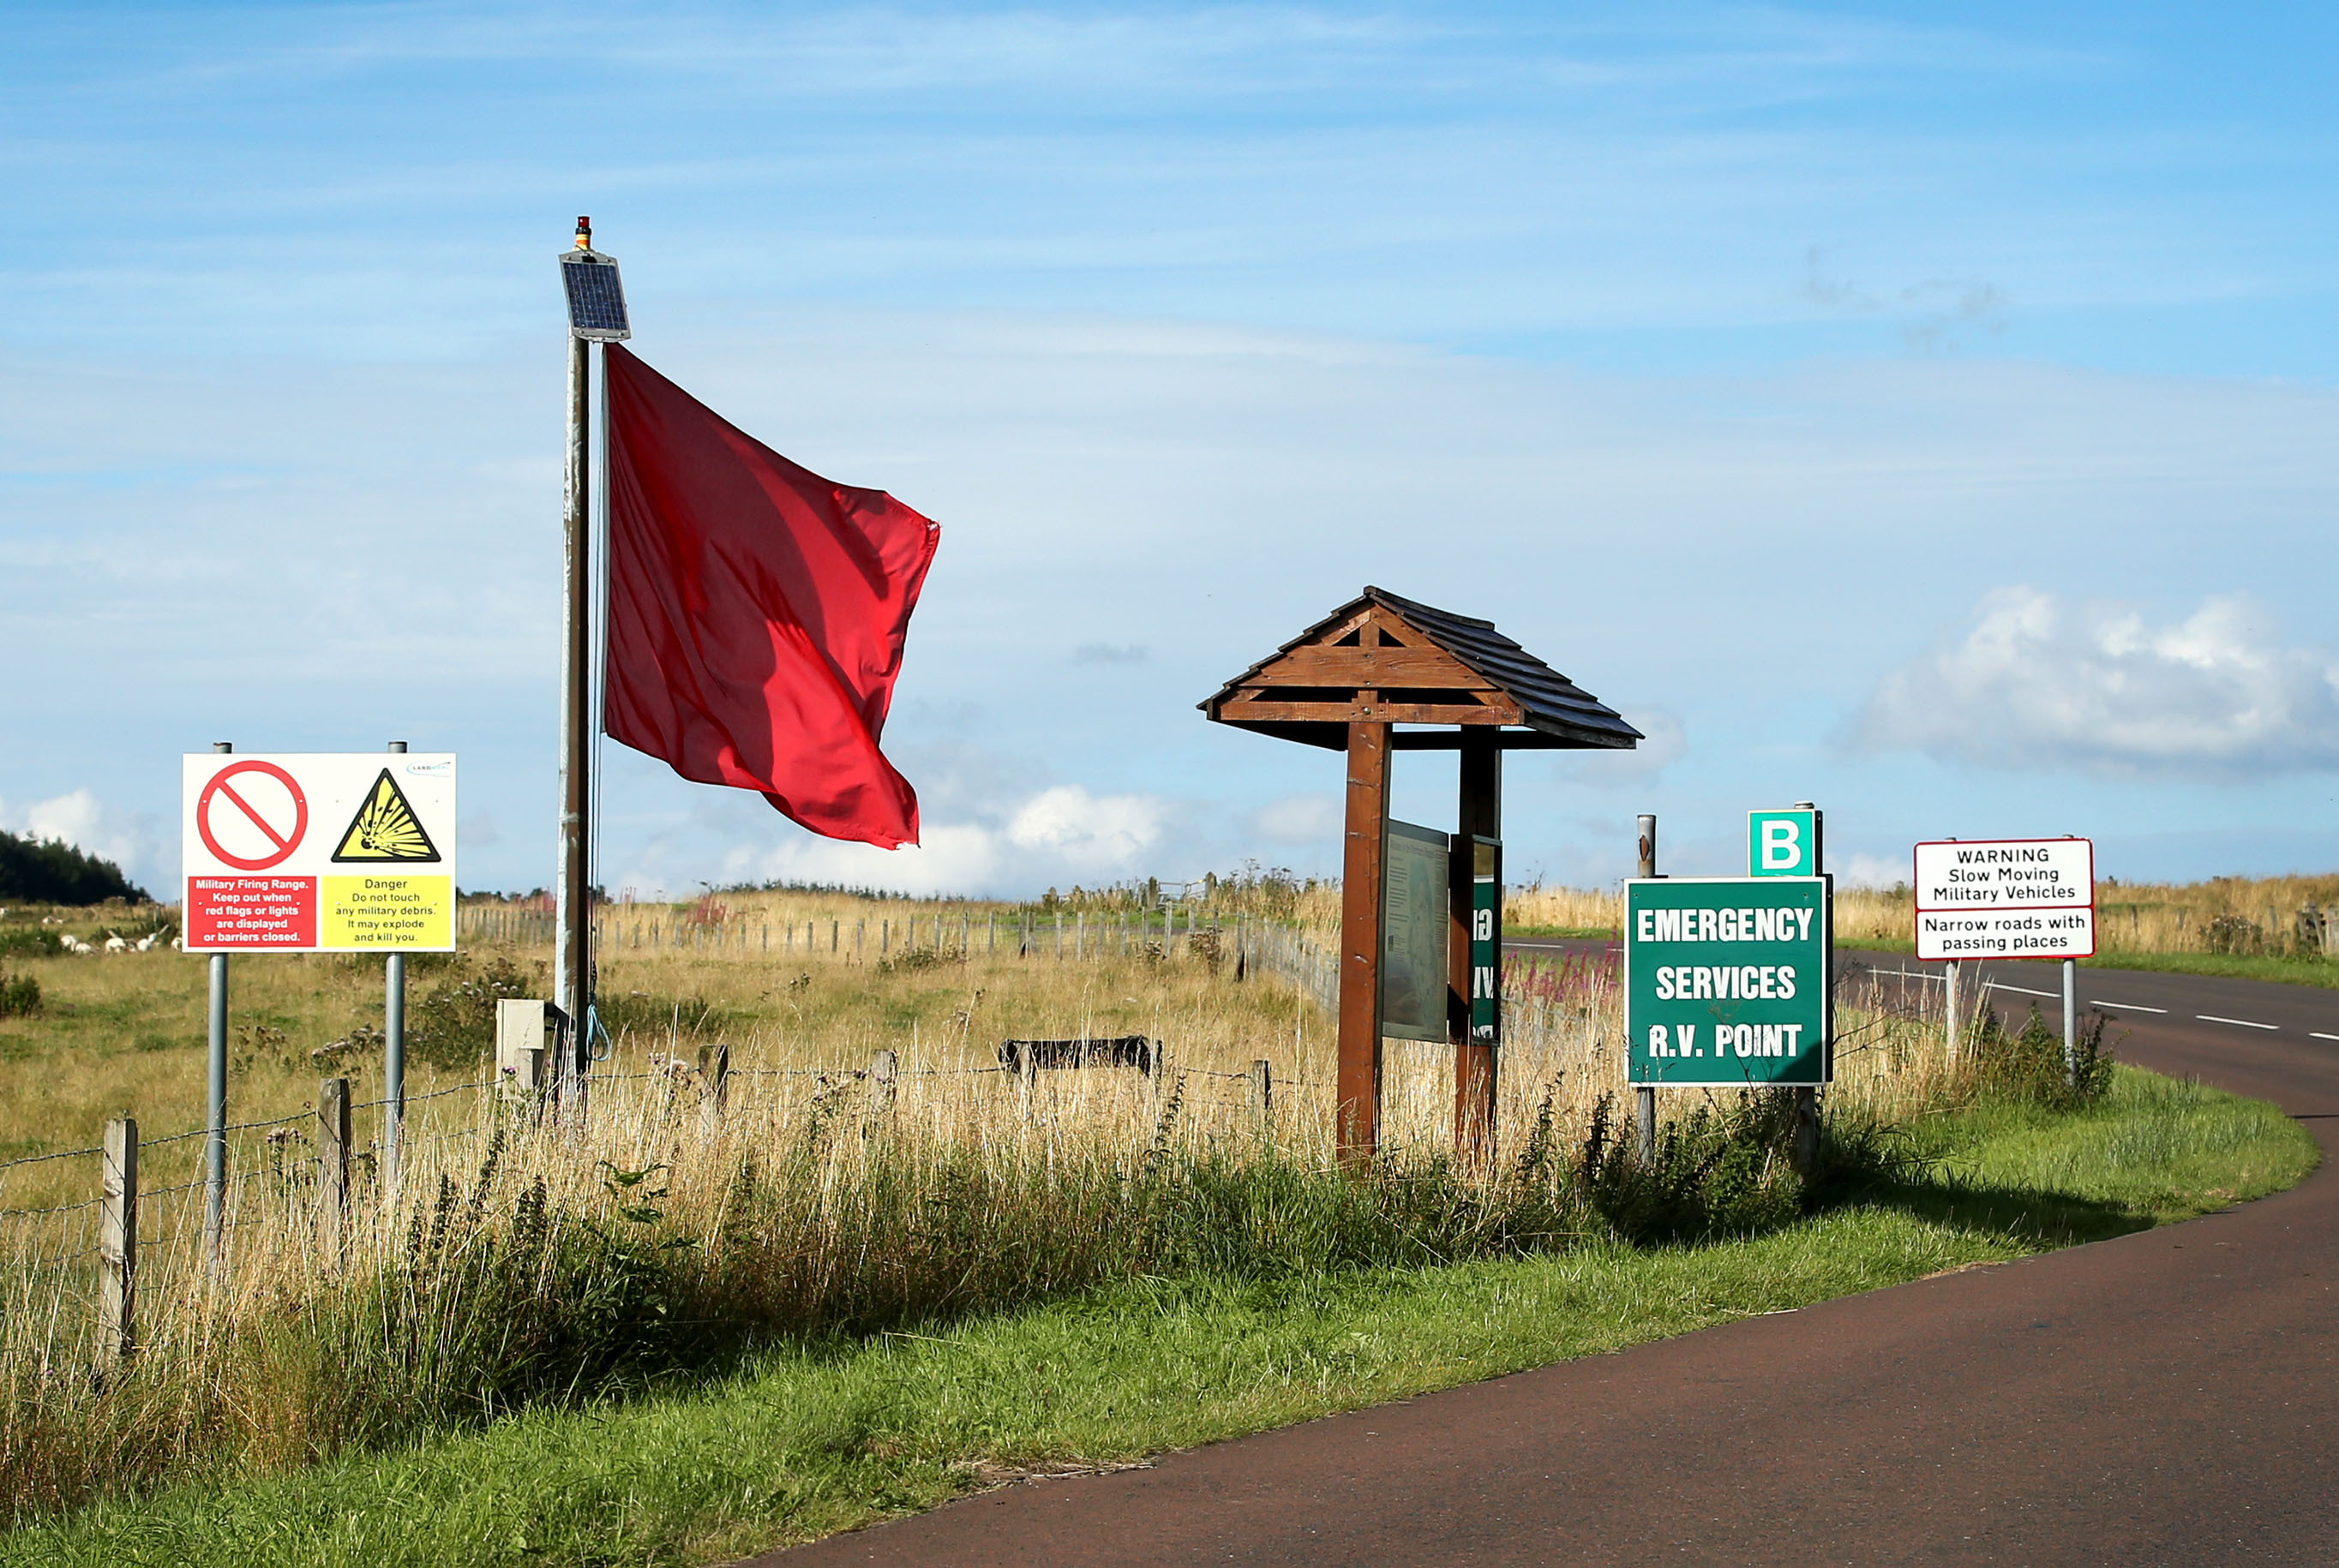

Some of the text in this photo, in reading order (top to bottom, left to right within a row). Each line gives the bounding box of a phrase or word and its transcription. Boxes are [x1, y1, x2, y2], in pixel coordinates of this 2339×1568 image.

[1761, 820, 1801, 870] B
[1958, 849, 2049, 864] WARNING
[1949, 867, 2059, 883] Slow Moving
[196, 880, 308, 891] Military Firing Range.
[365, 879, 407, 890] Danger
[213, 893, 291, 904] Keep out when
[390, 893, 420, 902] touch
[1934, 885, 2075, 902] Military Vehicles
[206, 906, 224, 915] red
[226, 906, 252, 917] flags
[269, 906, 298, 917] lights
[336, 906, 436, 917] any military debris.
[237, 919, 288, 931] displayed
[357, 921, 380, 931] may
[383, 919, 424, 931] explode
[1637, 907, 1814, 942] EMERGENCY
[1926, 915, 2085, 931] Narrow roads with
[218, 932, 259, 941] barriers
[262, 932, 300, 941] closed.
[396, 934, 417, 943] you.
[1943, 935, 2067, 951] passing places
[1656, 966, 1796, 1000] SERVICES
[1649, 1024, 1802, 1057] R.V. POINT
